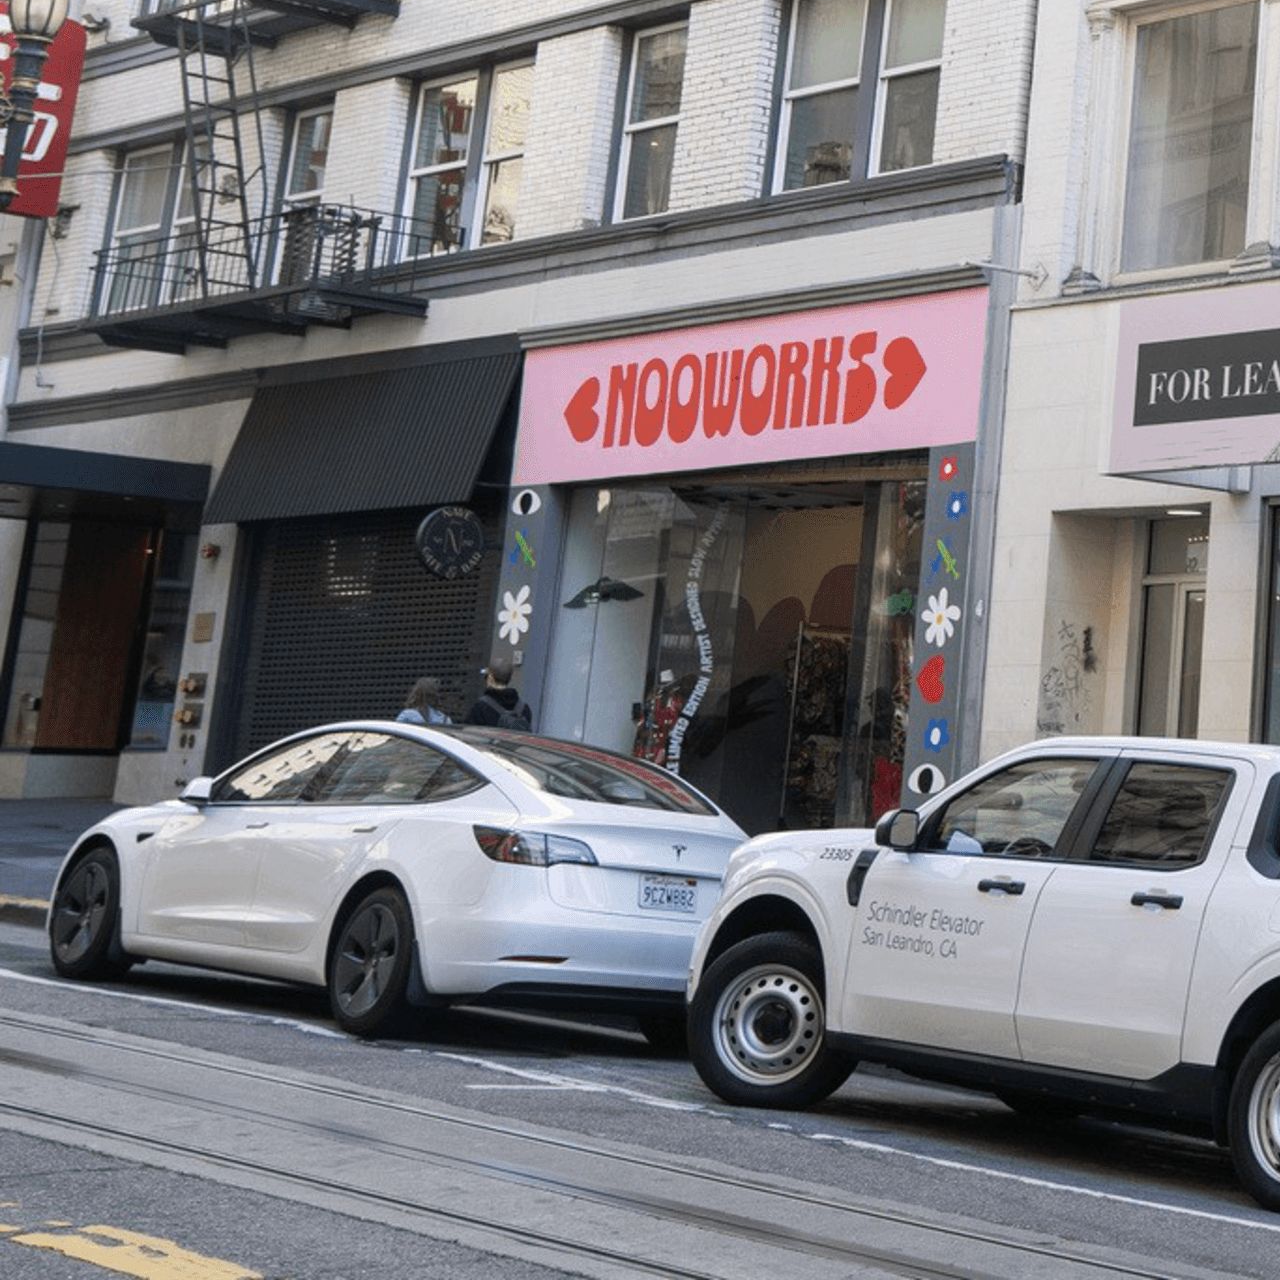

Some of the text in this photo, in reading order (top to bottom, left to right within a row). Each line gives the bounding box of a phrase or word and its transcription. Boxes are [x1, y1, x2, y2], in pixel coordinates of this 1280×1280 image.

[602, 331, 878, 448] NOOWORKS
[1148, 367, 1212, 406] FOR
[686, 581, 706, 632] DESIGNED
[697, 633, 713, 673] ARTIST
[682, 676, 711, 717] EDITION
[667, 716, 690, 759] LIMITED
[820, 847, 855, 861] 23305
[867, 901, 984, 936] Schindler Elevator
[862, 926, 957, 958] San Leandro, CA
